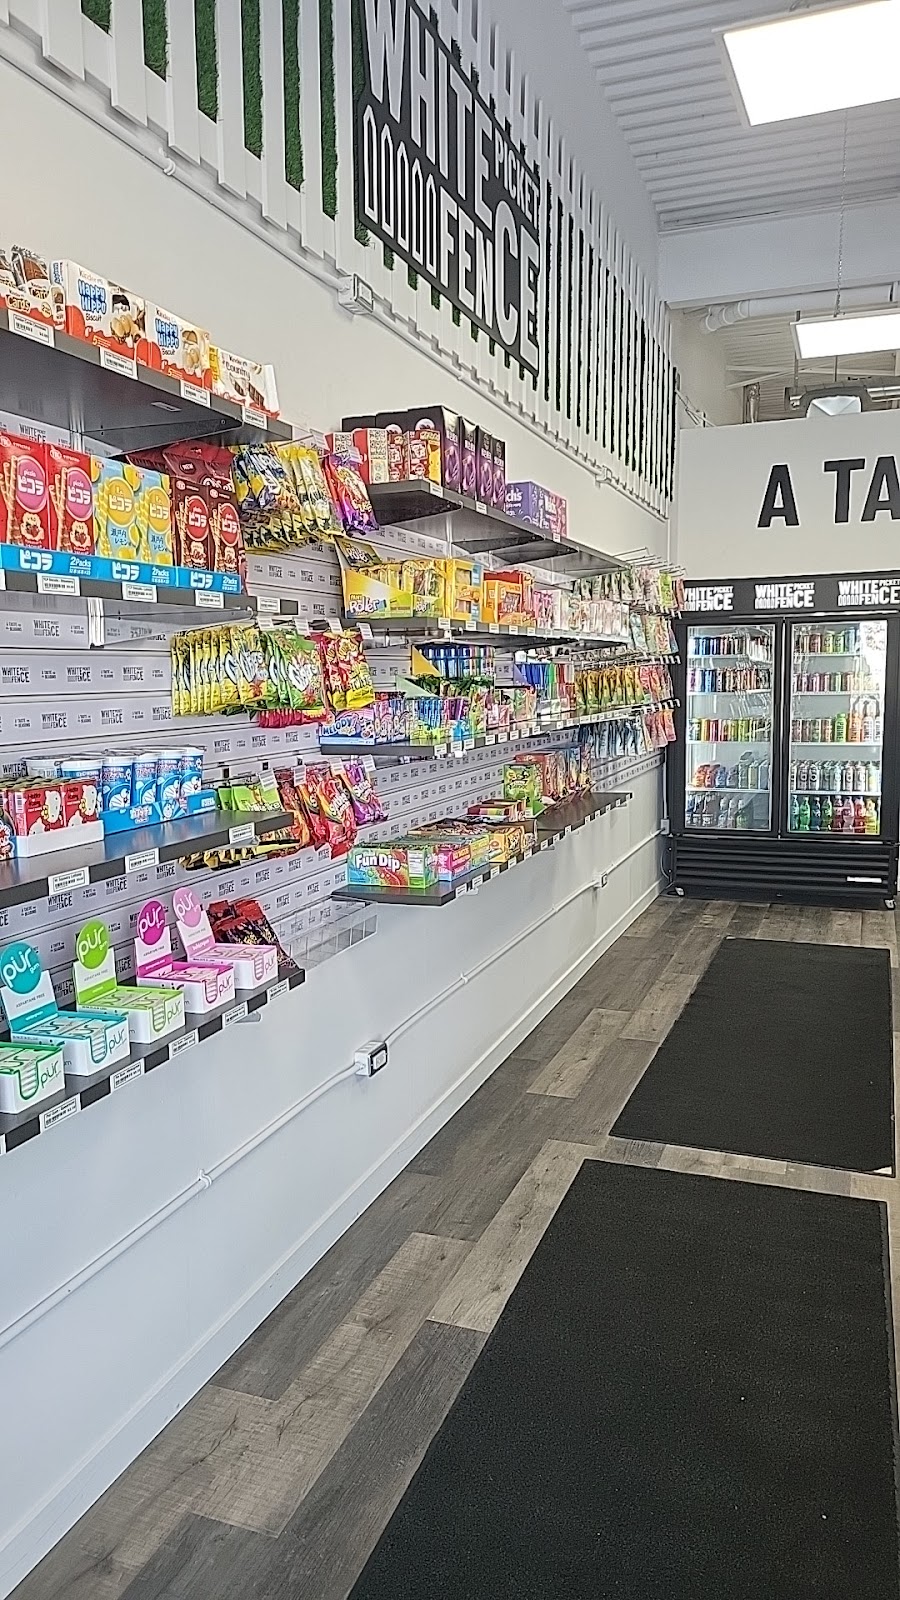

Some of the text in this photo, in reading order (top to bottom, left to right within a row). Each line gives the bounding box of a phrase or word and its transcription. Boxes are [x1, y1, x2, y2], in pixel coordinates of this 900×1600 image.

[365, 0, 493, 232] WHITE
[495, 128, 539, 230] PICKET
[440, 186, 540, 371] FENCE
[80, 296, 107, 314] Hippo
[85, 312, 102, 323] Biscuit
[18, 475, 45, 496] ピコラ
[67, 486, 91, 506] ピコラ
[109, 495, 132, 512] ピコラ
[757, 464, 800, 528] A
[150, 504, 169, 520] ピコラ
[188, 511, 208, 529] ピコラ
[20, 549, 53, 571] ピコラ
[112, 561, 140, 581] ピコラ
[190, 571, 213, 589] ピコラ
[714, 586, 733, 595] PICKET
[755, 583, 793, 599] WHITE
[793, 582, 814, 591] PICKET
[838, 580, 879, 595] WHITE
[879, 579, 900, 588] PICKET
[349, 596, 379, 613] Roller
[695, 593, 733, 611] FENCE
[774, 590, 815, 609] FENCE
[858, 586, 900, 606] FENCE
[323, 717, 352, 735] MELODY
[355, 853, 401, 873] Fun Dip
